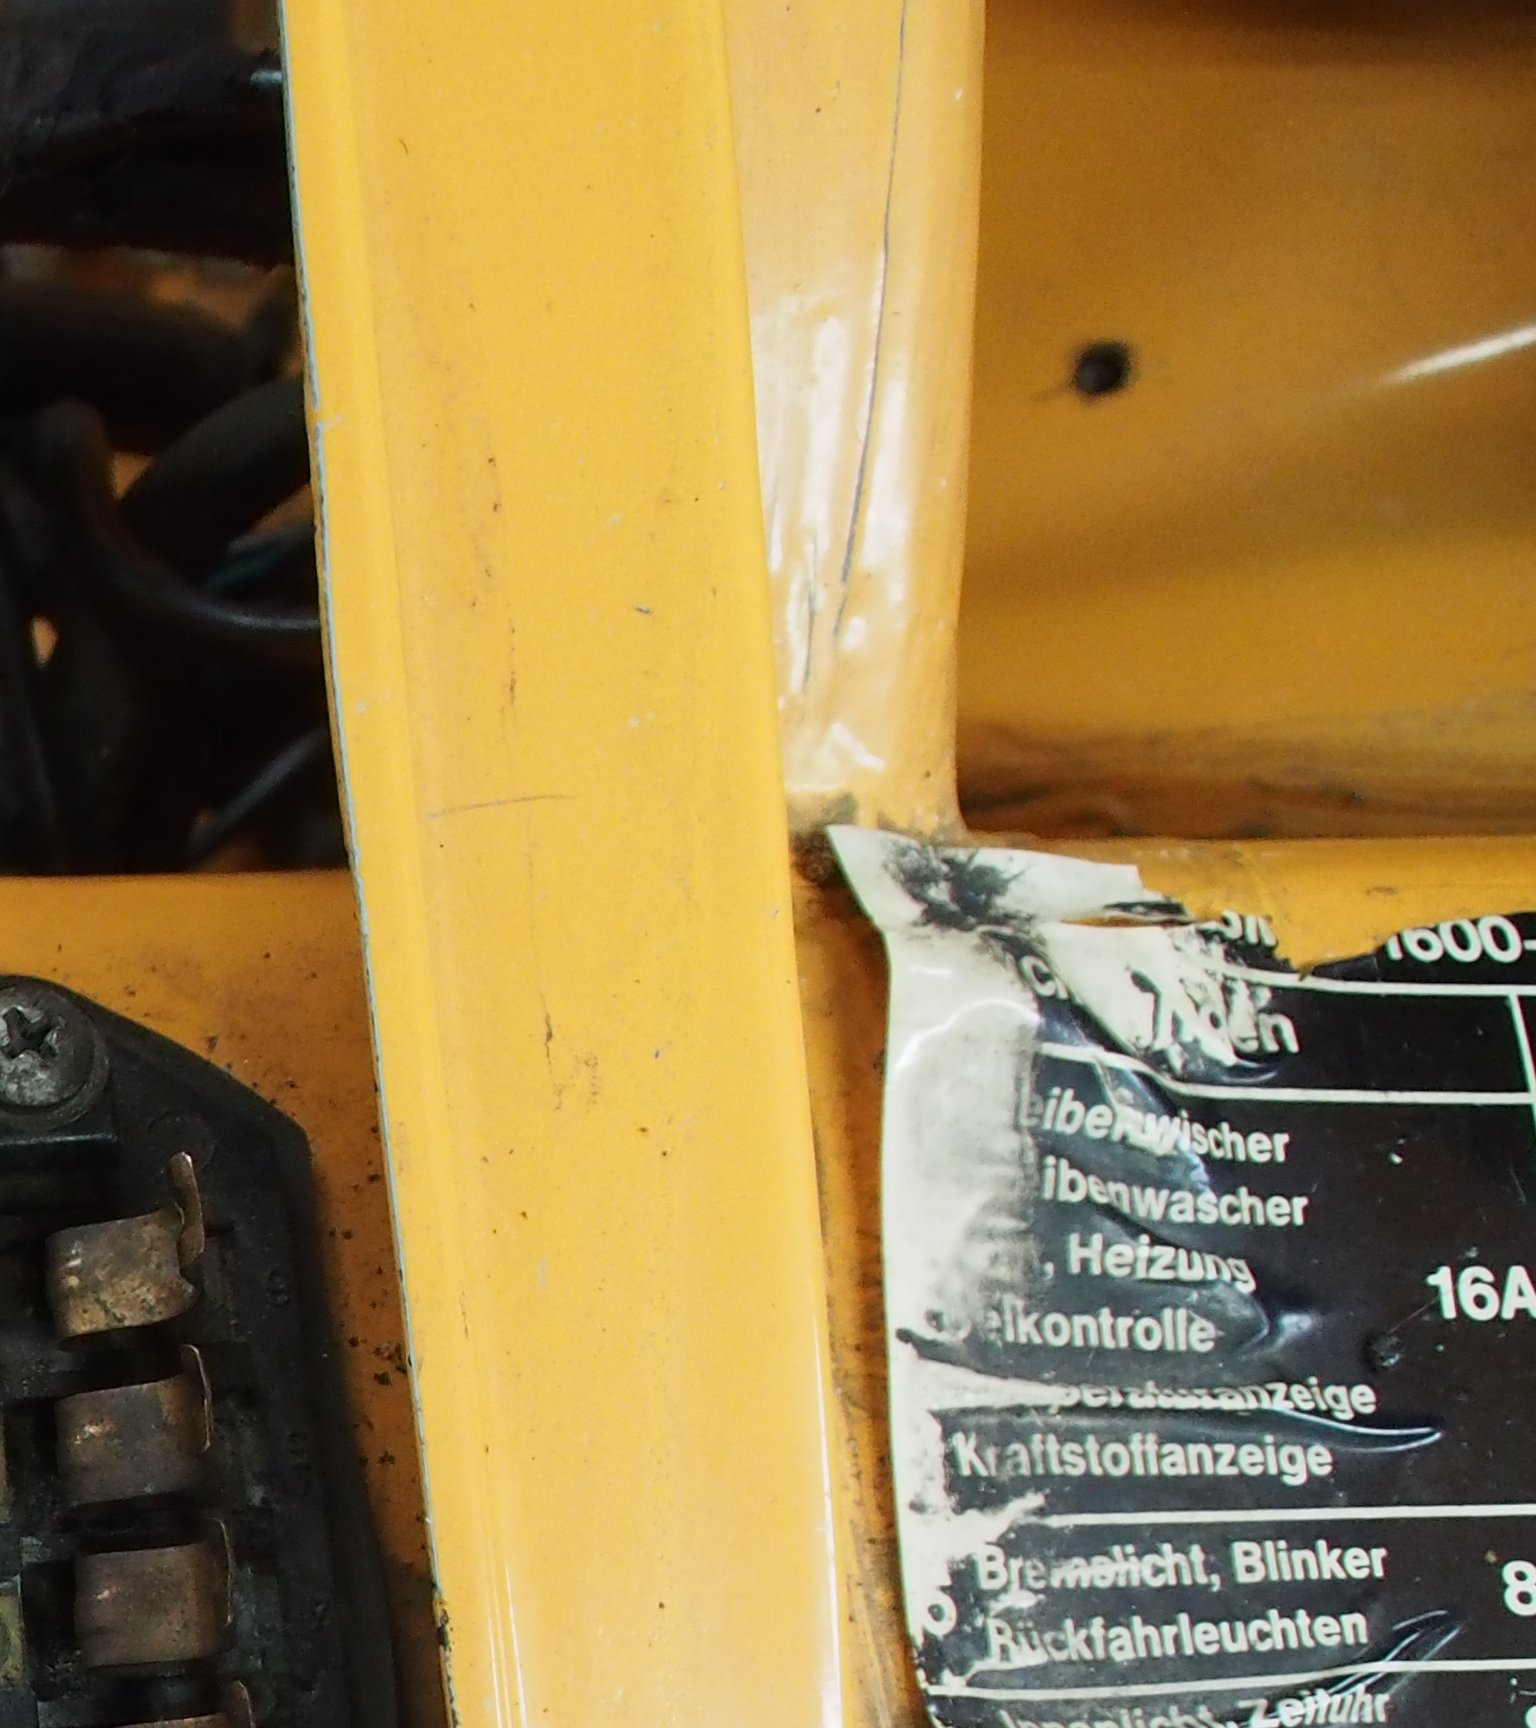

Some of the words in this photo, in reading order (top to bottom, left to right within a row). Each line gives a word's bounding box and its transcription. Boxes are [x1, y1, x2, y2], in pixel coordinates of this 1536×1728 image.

[1067, 1232, 1257, 1294] Heizung
[955, 1430, 1336, 1488] Kraftstoffanzeige
[1233, 1538, 1390, 1584] Blinker
